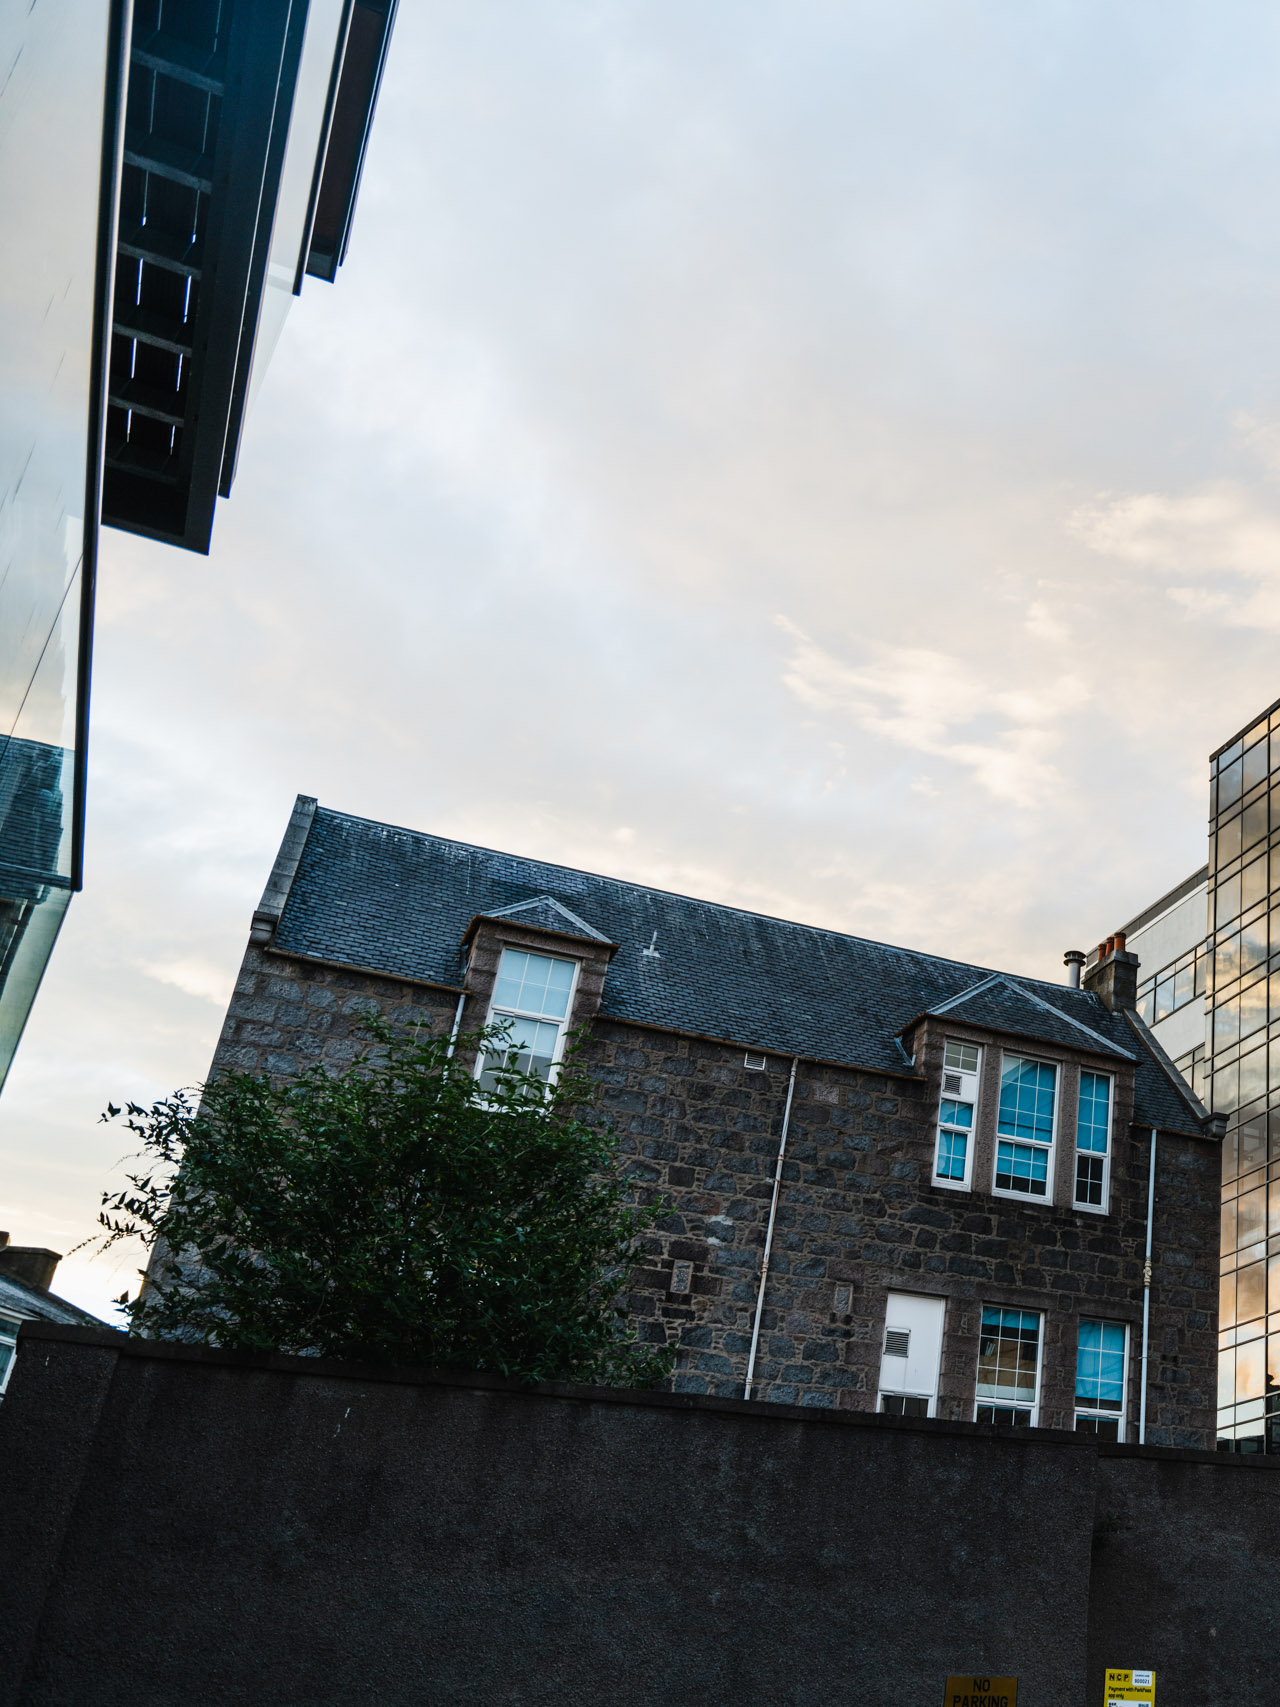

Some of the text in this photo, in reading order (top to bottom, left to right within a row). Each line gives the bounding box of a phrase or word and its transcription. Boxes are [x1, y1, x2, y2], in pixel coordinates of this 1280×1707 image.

[1109, 1673, 1129, 1682] NCP
[973, 1679, 991, 1692] NO
[953, 1695, 1009, 1707] PARKING
